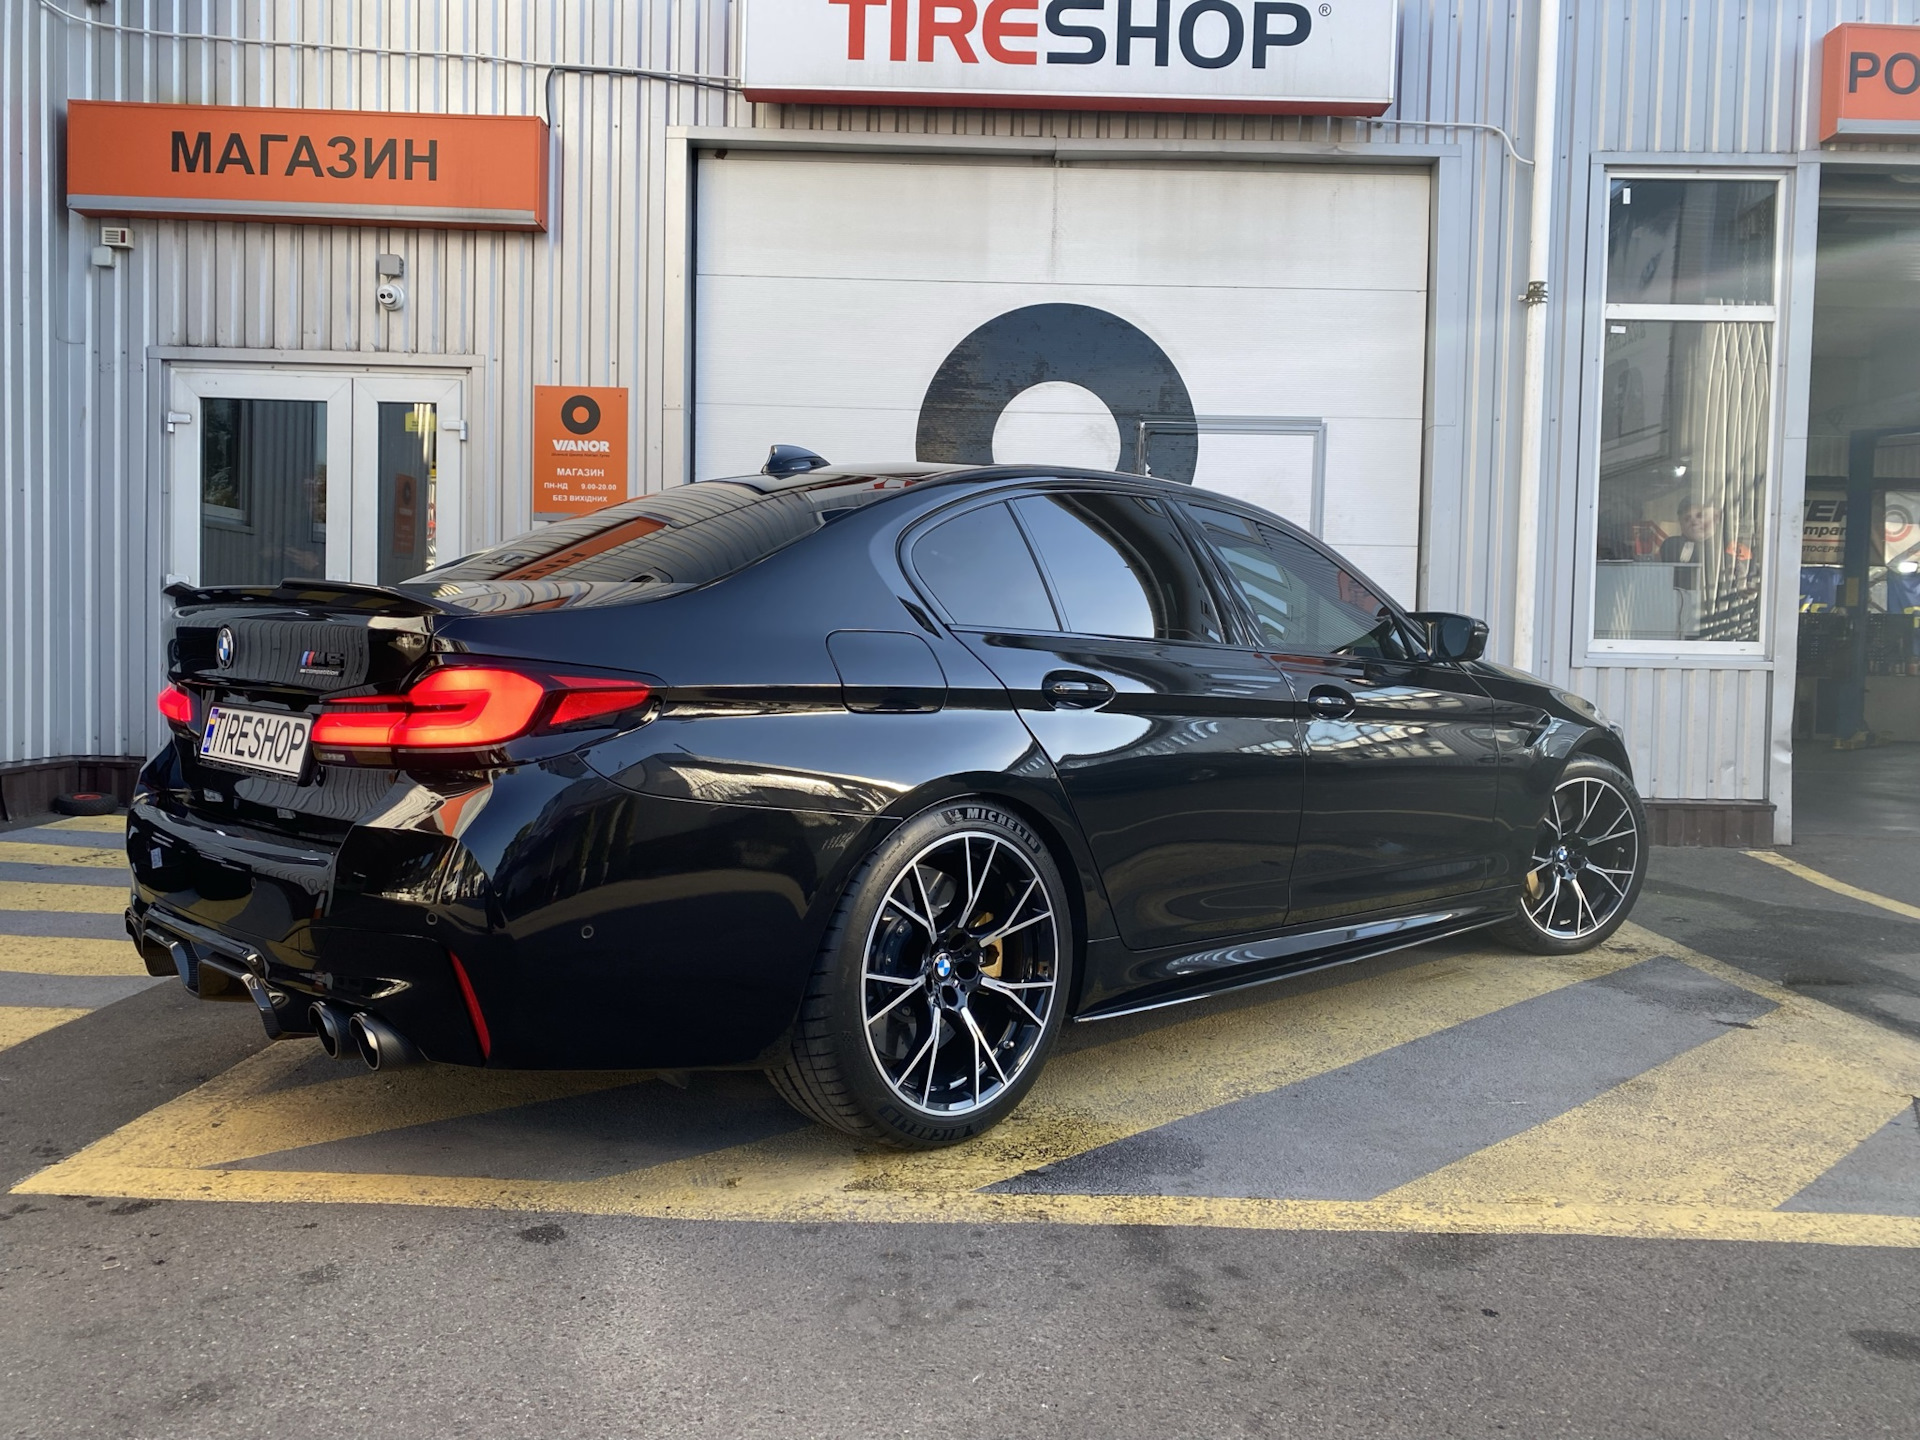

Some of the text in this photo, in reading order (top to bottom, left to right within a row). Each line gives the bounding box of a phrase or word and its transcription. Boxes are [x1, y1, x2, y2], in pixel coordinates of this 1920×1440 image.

[828, 0, 1312, 69] TIRESHOP
[171, 130, 437, 181] МАГАЗИН
[552, 439, 610, 452] VIANOR
[556, 468, 604, 477] МАГАЗИН
[544, 482, 616, 491] ПН-НД 9.00-20.00
[552, 494, 608, 503] БЕЗ ВИХІДНИХ
[213, 713, 306, 765] TIRESHOP
[966, 808, 1038, 850] MICHELIN
